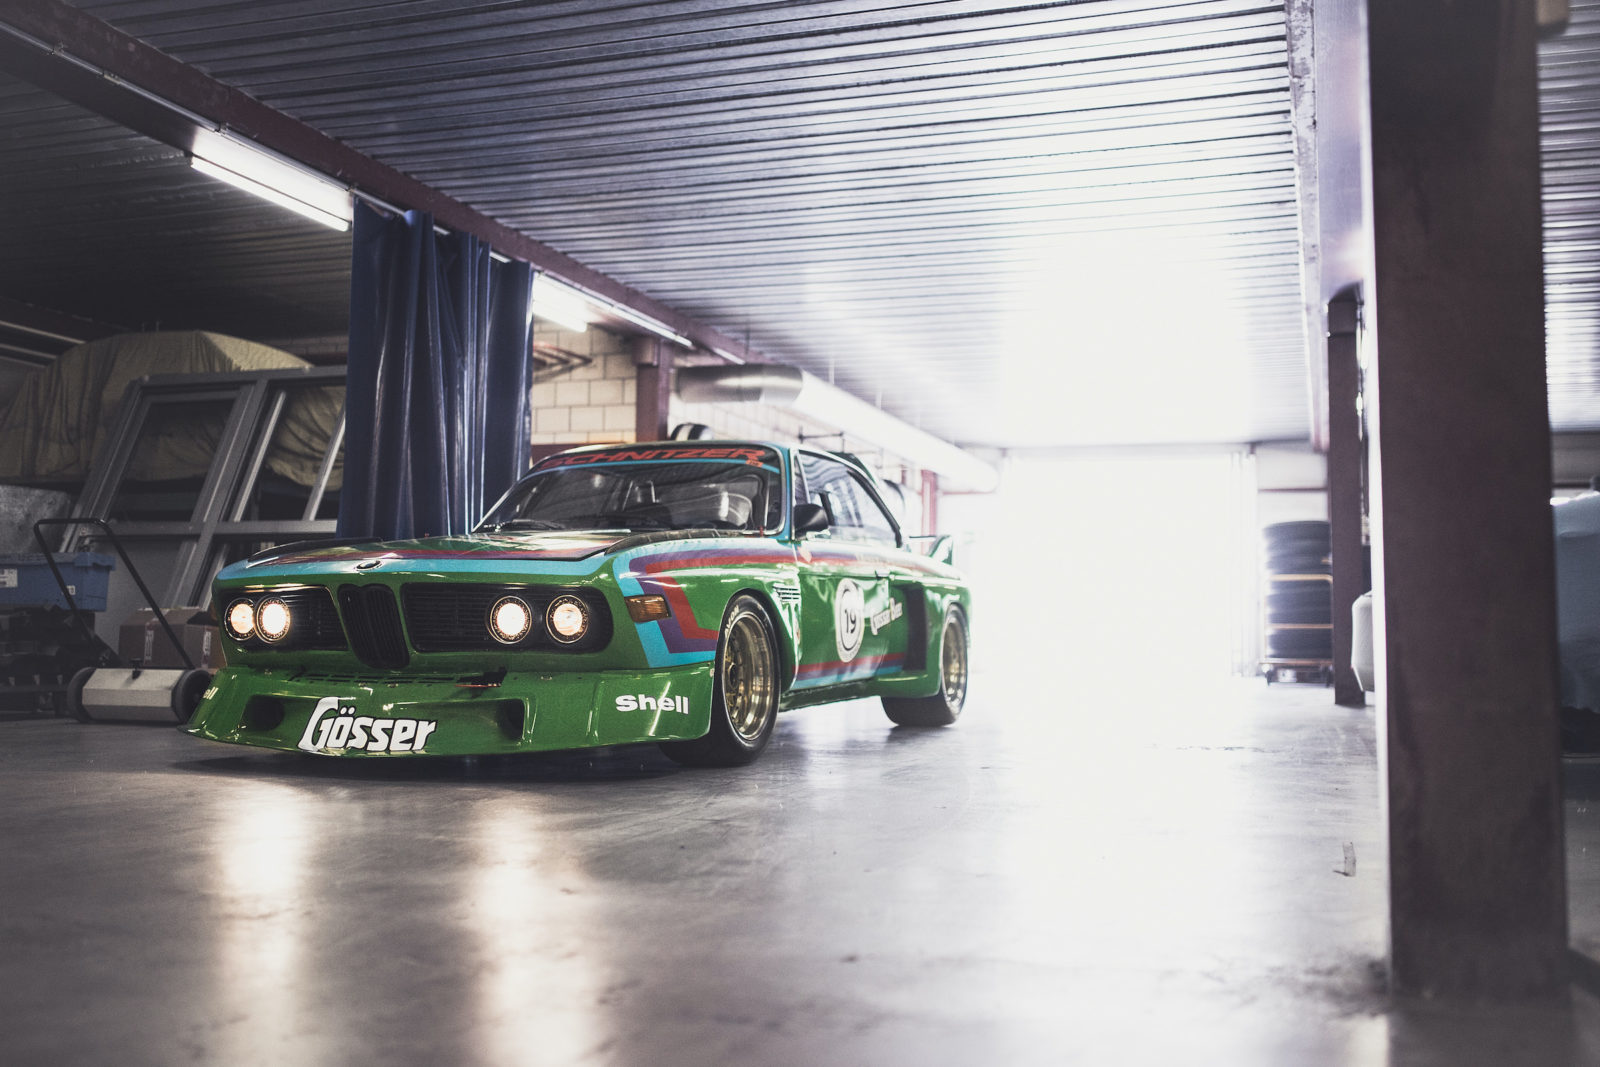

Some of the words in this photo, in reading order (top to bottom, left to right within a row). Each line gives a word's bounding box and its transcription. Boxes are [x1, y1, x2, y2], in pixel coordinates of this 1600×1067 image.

[540, 449, 766, 471] SCHNITZER
[844, 609, 856, 634] 19
[615, 694, 689, 715] Shell
[298, 696, 437, 752] Gösser
